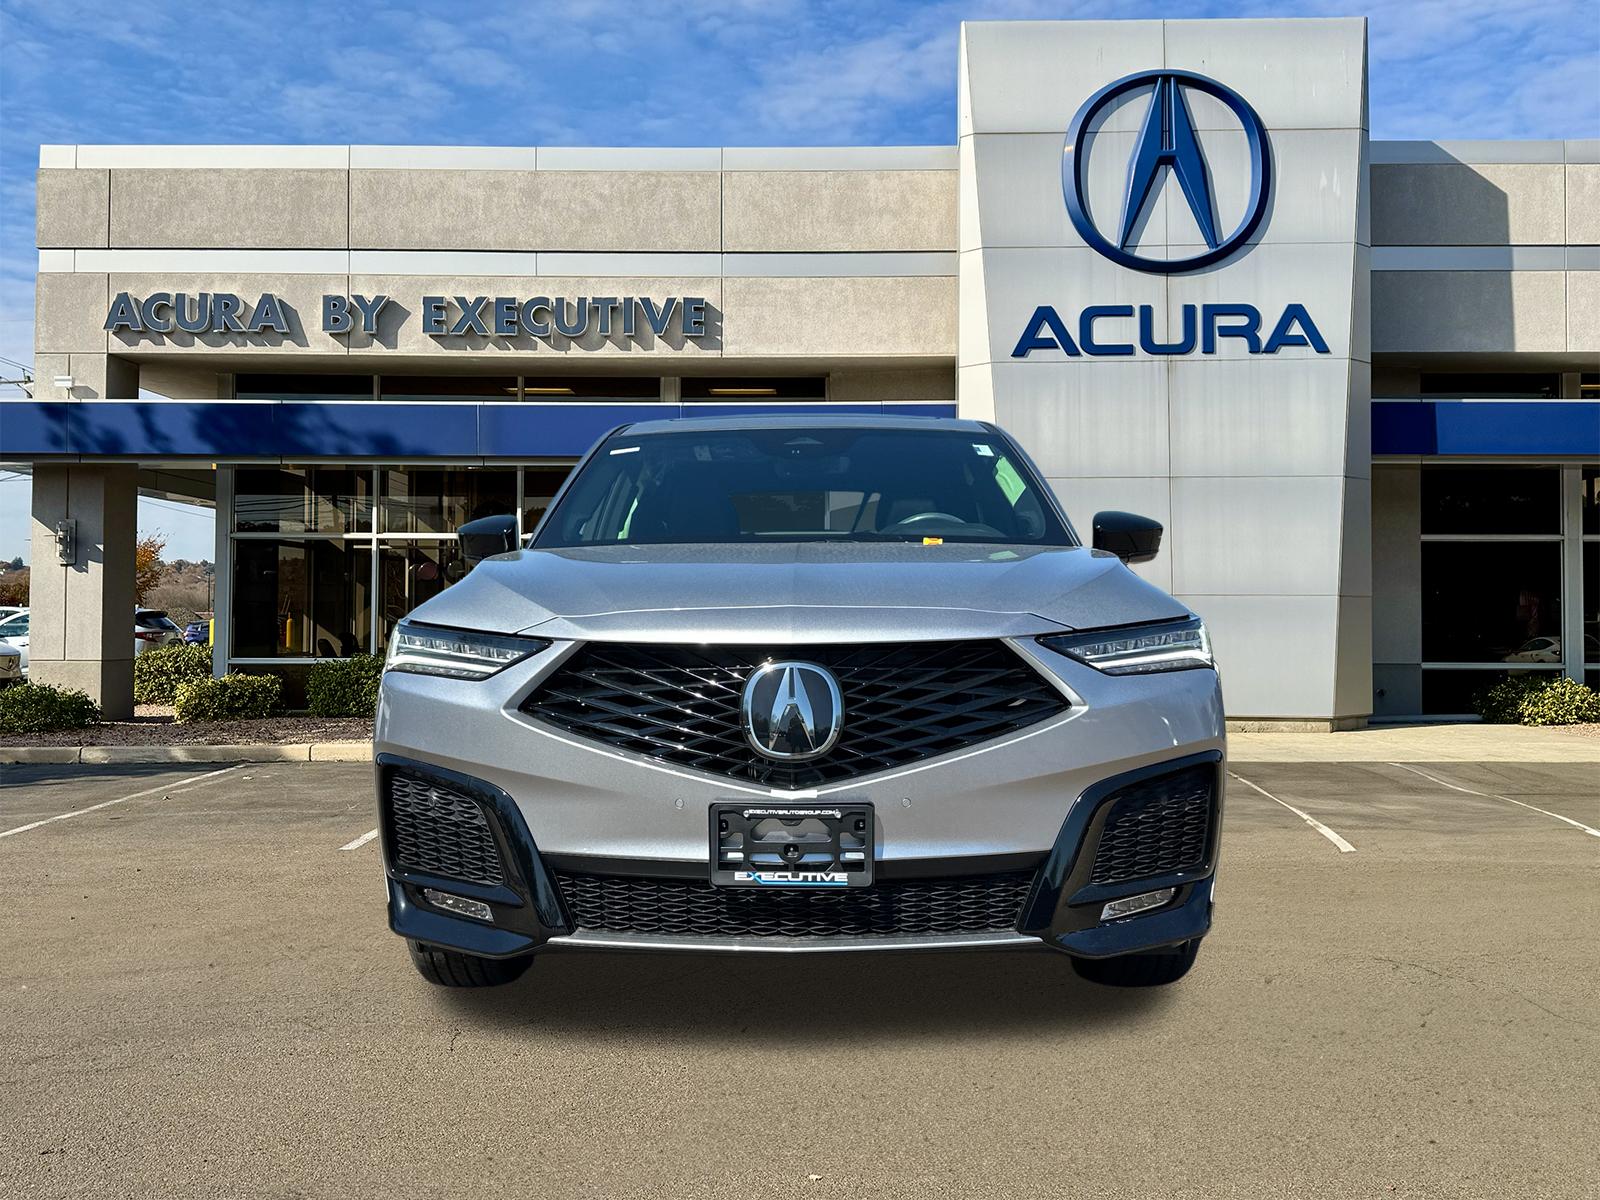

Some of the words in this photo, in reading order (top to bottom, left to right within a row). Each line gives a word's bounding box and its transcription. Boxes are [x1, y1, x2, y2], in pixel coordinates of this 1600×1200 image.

[103, 291, 290, 334] ACURA
[322, 294, 391, 334] BY
[422, 295, 706, 337] EXECUTIVE
[1010, 303, 1332, 357] ACURA
[734, 871, 849, 883] EXECUTIVE
